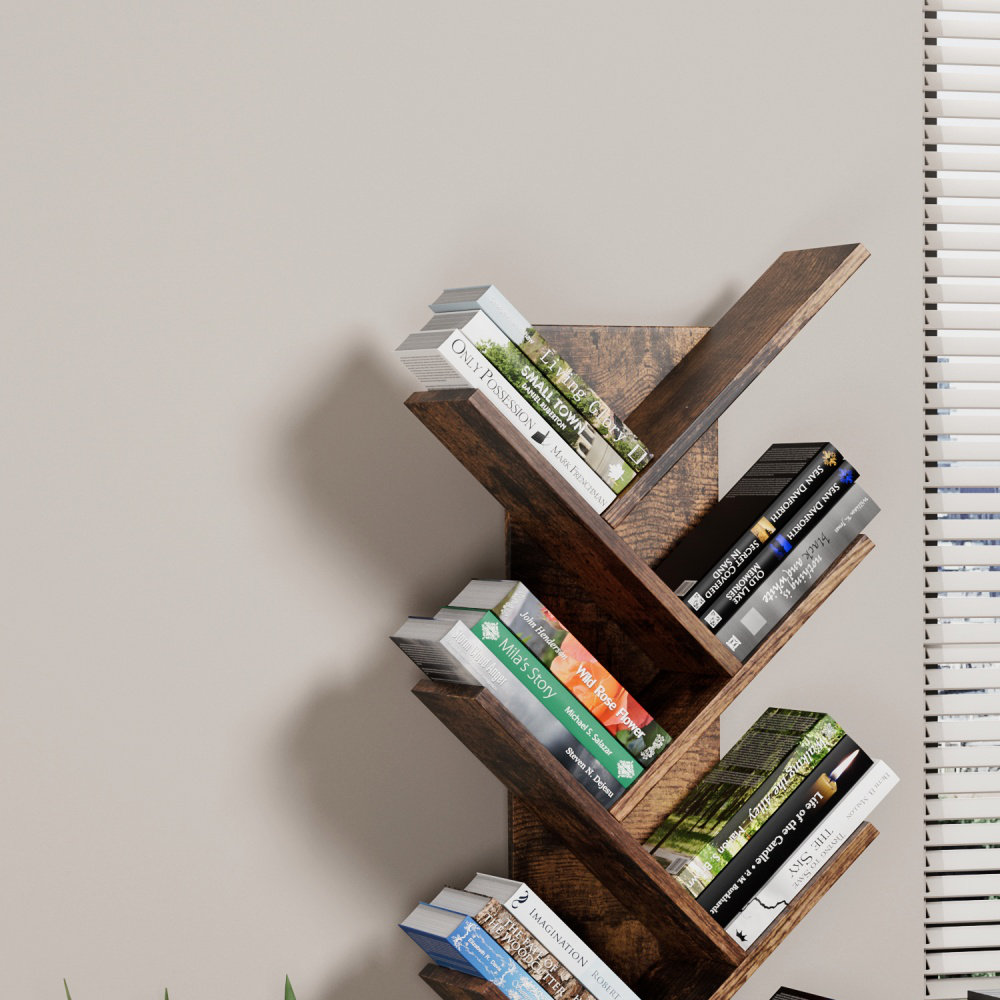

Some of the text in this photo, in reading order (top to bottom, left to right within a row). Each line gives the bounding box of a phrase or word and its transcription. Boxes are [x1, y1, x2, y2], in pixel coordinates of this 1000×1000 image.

[451, 338, 536, 430] ONLY POSSESSION
[521, 382, 541, 404] DANIEL
[521, 364, 588, 435] SMALL TOWN
[535, 348, 630, 442] Living Glory
[550, 445, 607, 506] MARK FRENCHMAN
[770, 464, 824, 522] SEAN DANFORTH
[786, 482, 840, 540] SEAN DANFORTH
[705, 540, 759, 598] SECRET COVERED
[712, 548, 741, 579] IN SAND
[726, 562, 761, 600] MEMORIES
[732, 568, 764, 604] OLD LAKE
[762, 530, 832, 603] black and white
[780, 551, 822, 599] nothing is
[519, 612, 570, 661] John Henderson
[498, 638, 530, 672] Mila's
[527, 667, 557, 698] Story
[572, 664, 645, 738] Wild Rose Flower
[564, 706, 612, 756] Michael S. Salazar
[565, 747, 614, 798] Steven N. Dejesu
[785, 734, 830, 780] Walking
[748, 793, 776, 824] Alley
[770, 774, 790, 796] the
[755, 791, 824, 864] Life of the Candle
[788, 828, 834, 877] THE SKY
[683, 861, 712, 890] Brwn
[736, 875, 746, 884] M.
[810, 858, 820, 869] TO
[710, 883, 739, 914] Burkhardt
[483, 913, 505, 934] THE
[498, 929, 567, 997] WOODCUTTER
[503, 918, 526, 939] THE
[541, 956, 558, 972] OF
[529, 908, 588, 967] IMAGINATION
[591, 970, 620, 1000] ROBERT
